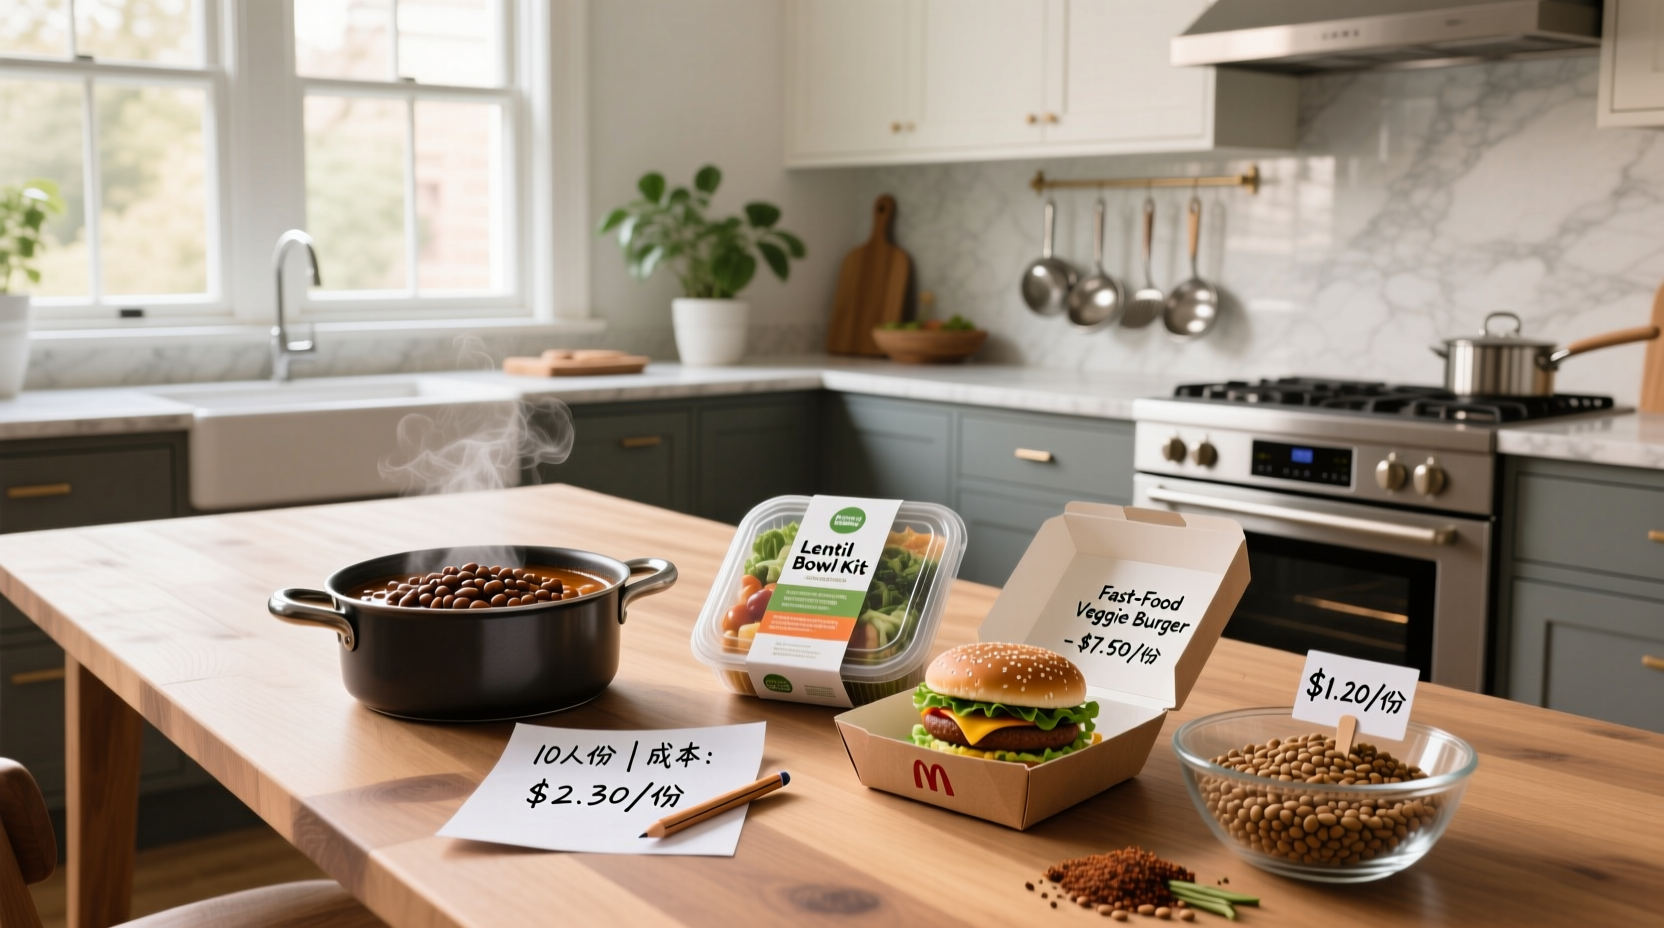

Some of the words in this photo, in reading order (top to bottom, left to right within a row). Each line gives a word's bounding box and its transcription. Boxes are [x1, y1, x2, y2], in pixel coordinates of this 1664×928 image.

[800, 540, 855, 557] Lentil
[792, 556, 838, 573] Bowl
[840, 559, 869, 575] Kit
[1098, 585, 1185, 611] Fast-Food
[1076, 601, 1129, 627] Veggie
[1132, 611, 1190, 636] Burger
[1306, 667, 1407, 714] $1.20/份
[533, 744, 617, 767] 10人份
[526, 778, 685, 813] $2.30/份
